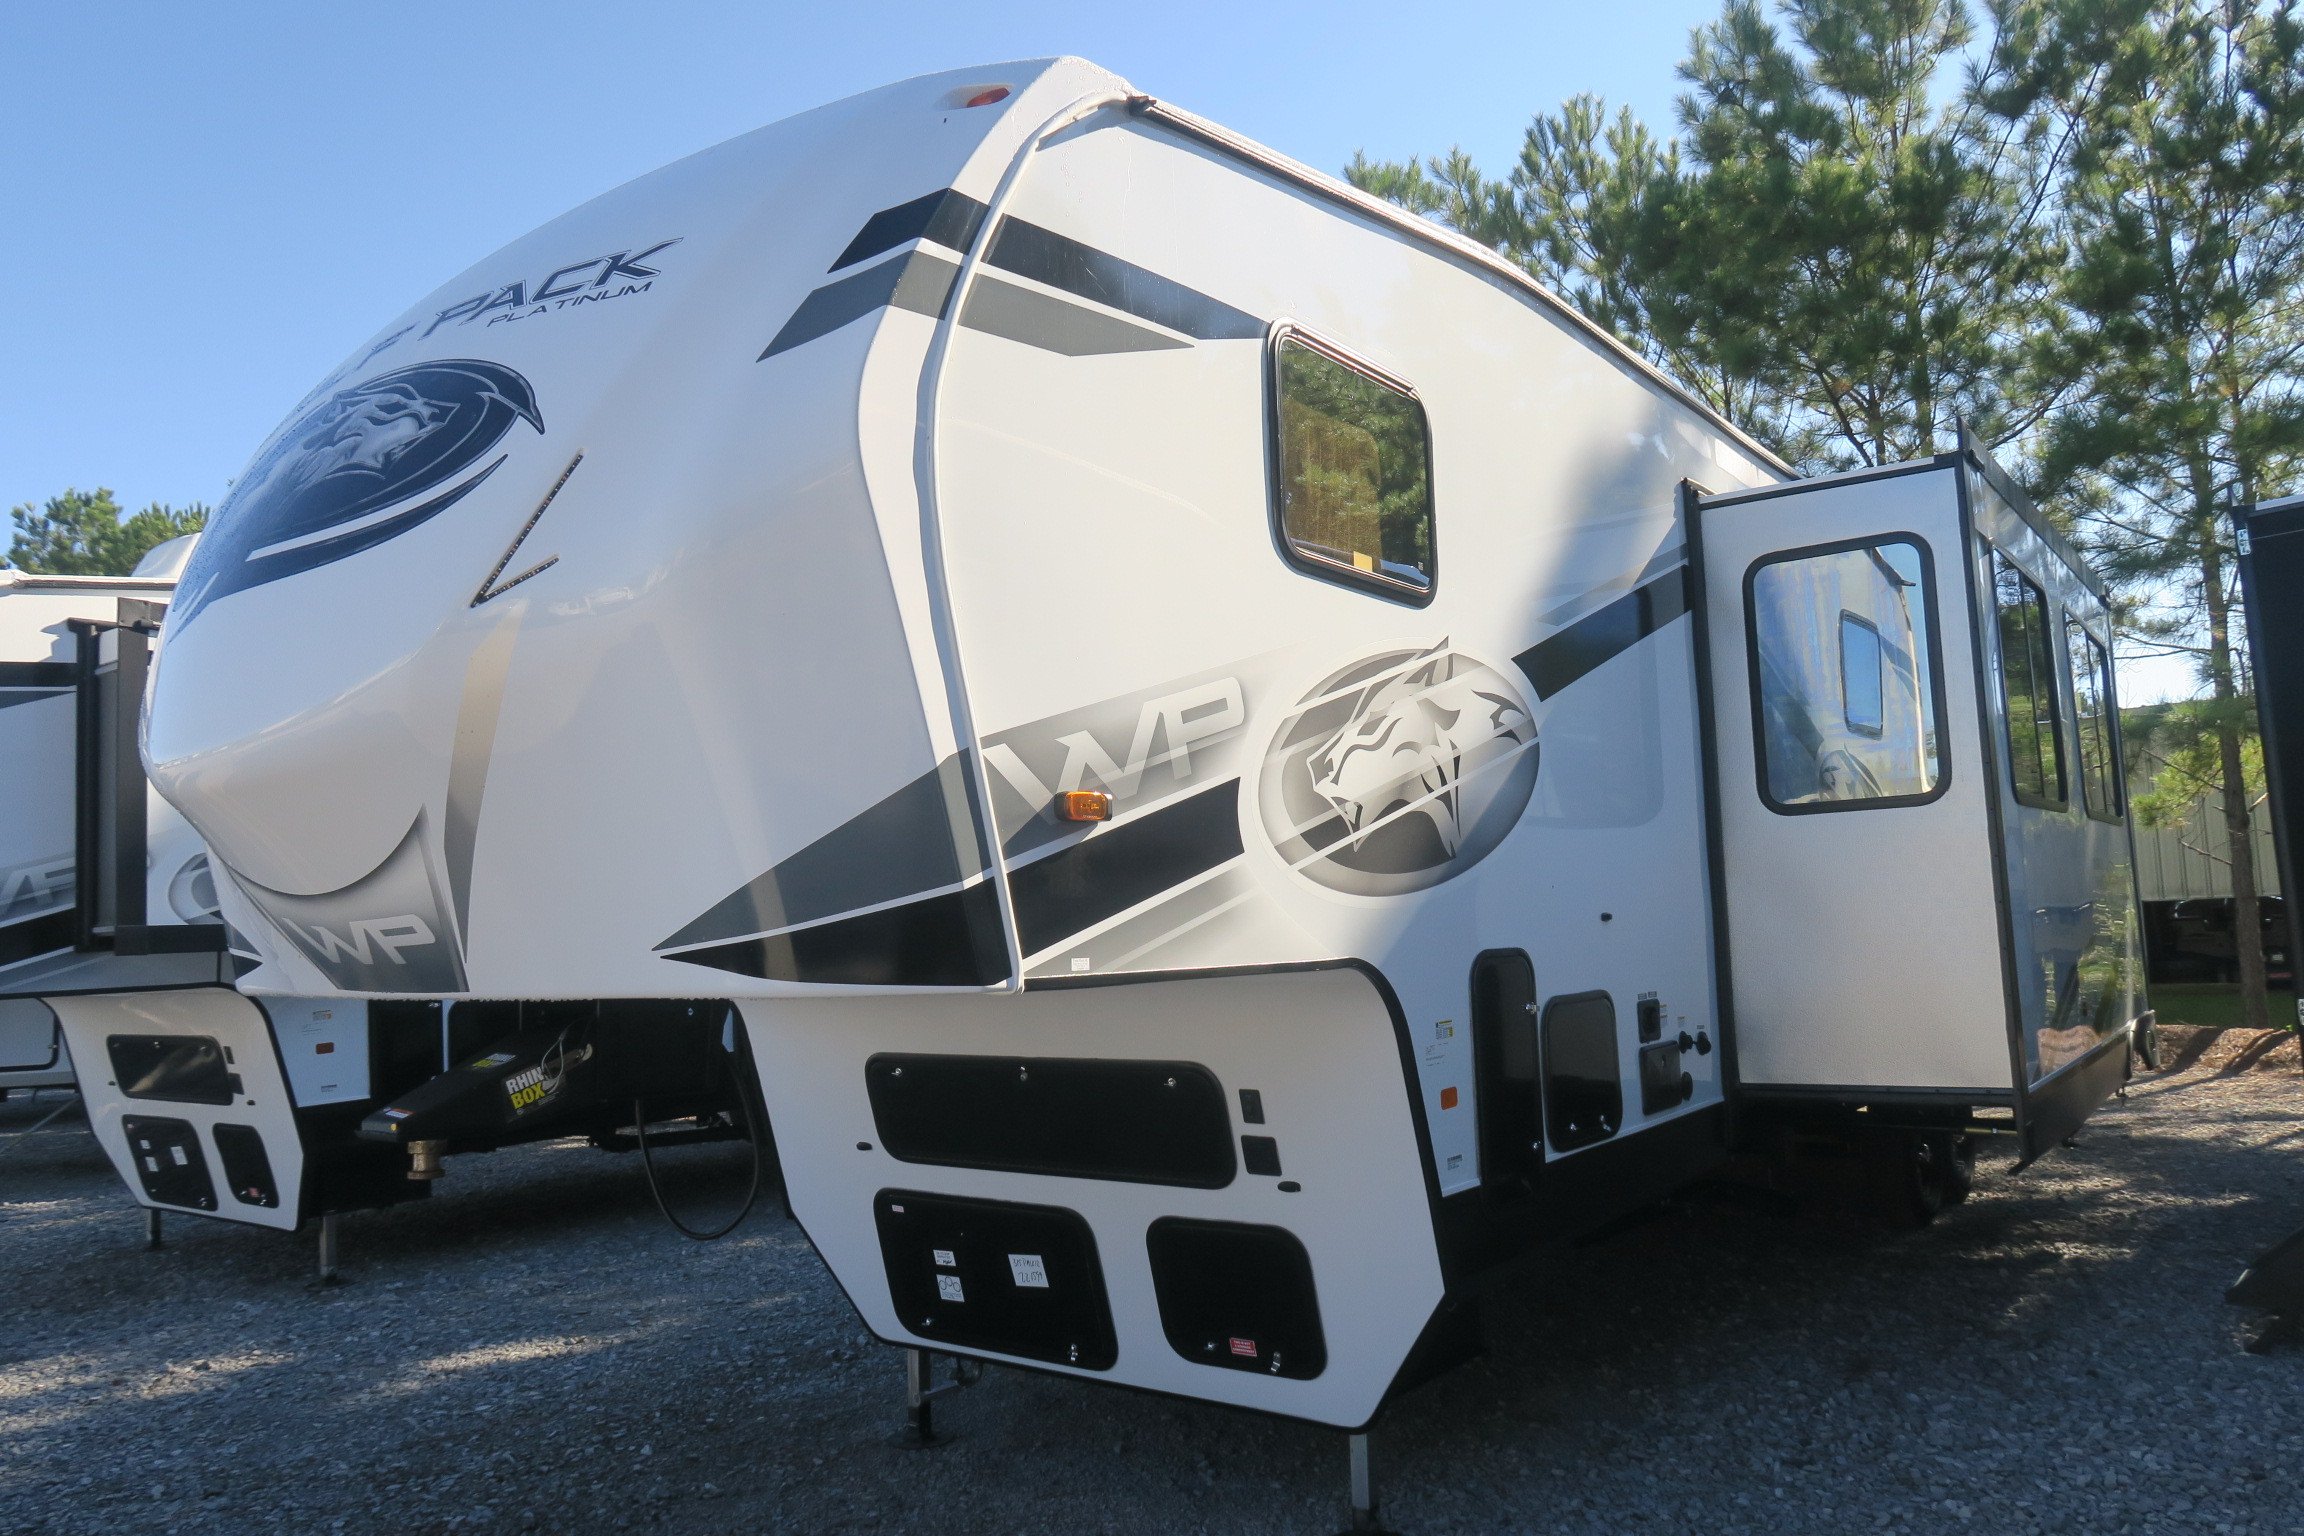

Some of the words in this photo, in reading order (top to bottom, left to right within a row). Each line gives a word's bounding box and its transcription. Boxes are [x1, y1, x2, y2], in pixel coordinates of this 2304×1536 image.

[417, 237, 684, 341] PACK
[487, 281, 653, 327] PLATINUM
[281, 913, 436, 965] WP
[511, 1082, 546, 1110] BOX
